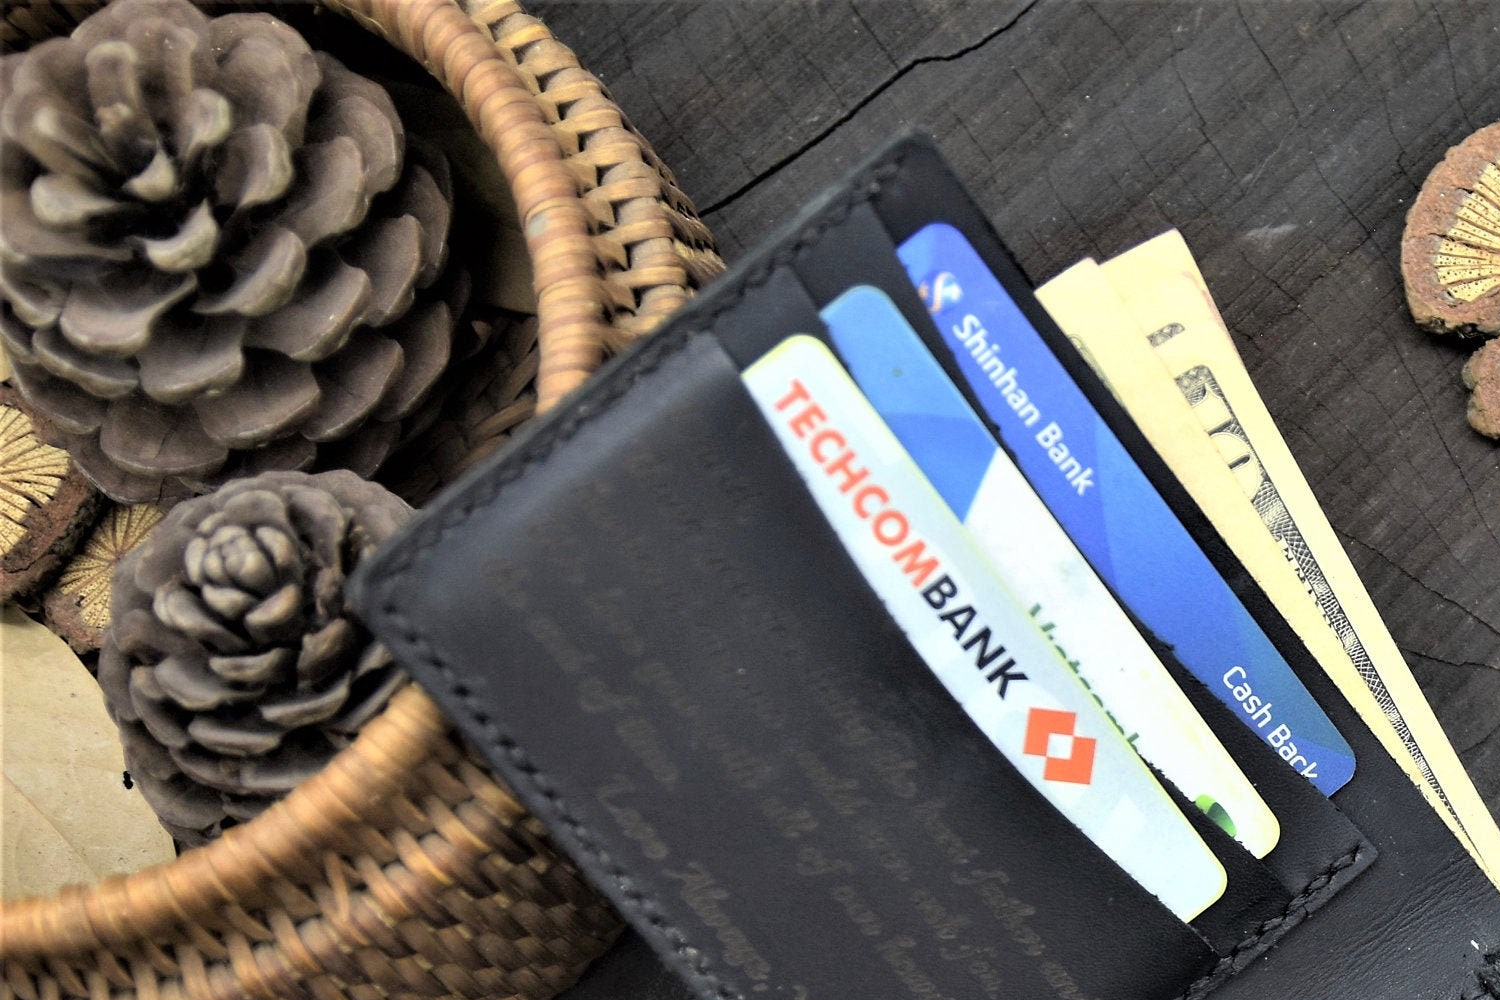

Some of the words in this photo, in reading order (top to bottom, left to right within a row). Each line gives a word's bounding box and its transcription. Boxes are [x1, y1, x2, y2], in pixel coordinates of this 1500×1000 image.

[952, 314, 1042, 428] Shinhan
[1035, 421, 1094, 496] Bank
[774, 379, 1029, 700] TECHCOMBANK
[525, 613, 594, 673] end
[578, 676, 640, 714] of
[1223, 666, 1272, 728] Cash
[1267, 723, 1318, 778] Back
[594, 772, 671, 860] Love
[661, 861, 773, 991] Always,
[759, 796, 818, 839] all
[796, 844, 855, 875] of
[831, 882, 885, 937] our
[907, 794, 979, 864] best
[950, 871, 1044, 957] father
[907, 886, 972, 937] ask
[938, 947, 996, 1000] for.
